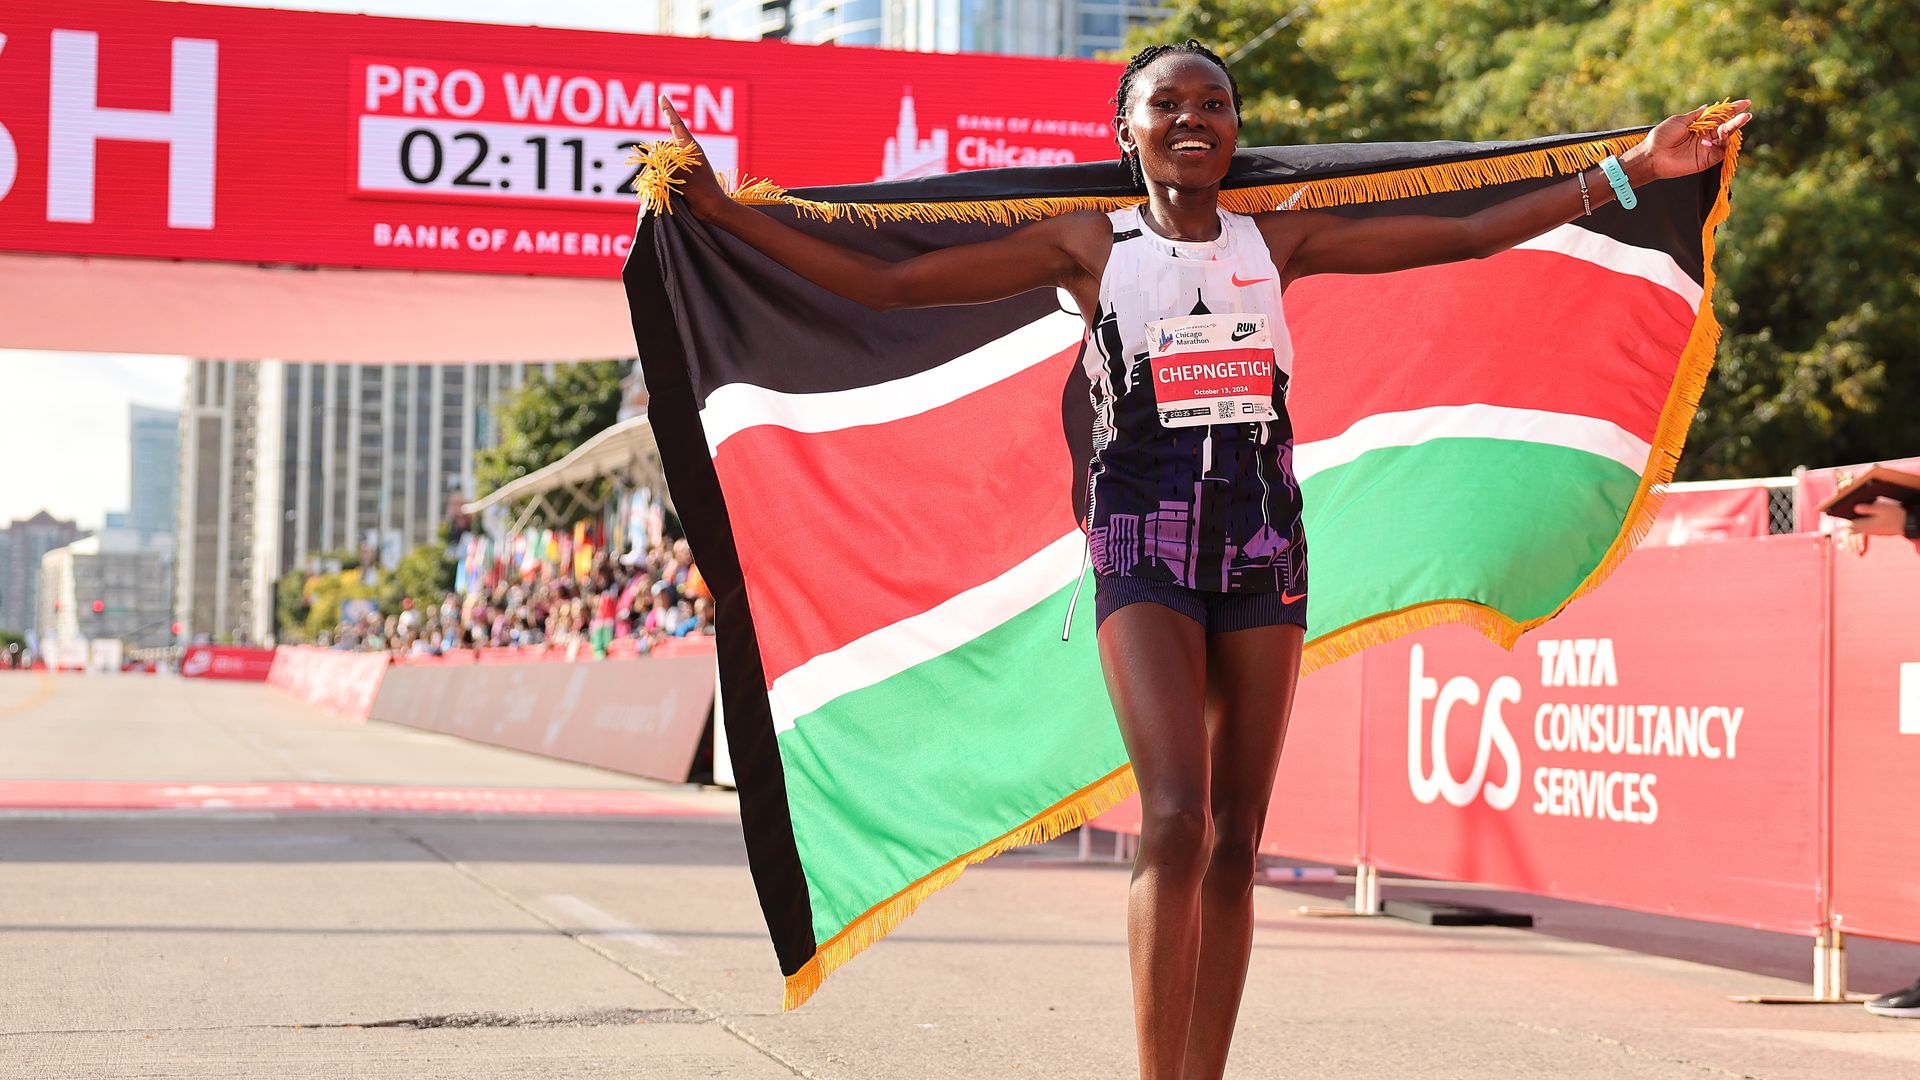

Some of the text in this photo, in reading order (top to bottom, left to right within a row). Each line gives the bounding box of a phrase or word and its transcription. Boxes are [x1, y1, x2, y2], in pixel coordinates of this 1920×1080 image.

[365, 64, 735, 132] PRO WOMEN
[0, 28, 219, 230] H
[956, 114, 1109, 138] BANK OF AMERICA
[400, 129, 649, 194] 02:11:2
[956, 136, 1076, 168] Chicago
[373, 222, 634, 257] BANK OF AMERIC
[1175, 331, 1203, 339] Chicago
[1236, 322, 1257, 333] RUN
[1158, 361, 1271, 384] CHEPNGETICH
[1537, 638, 1618, 686] TATA
[1408, 643, 1522, 811] tcs
[1533, 703, 1744, 759] CONSULTANCY
[1533, 767, 1659, 824] SERVICES
